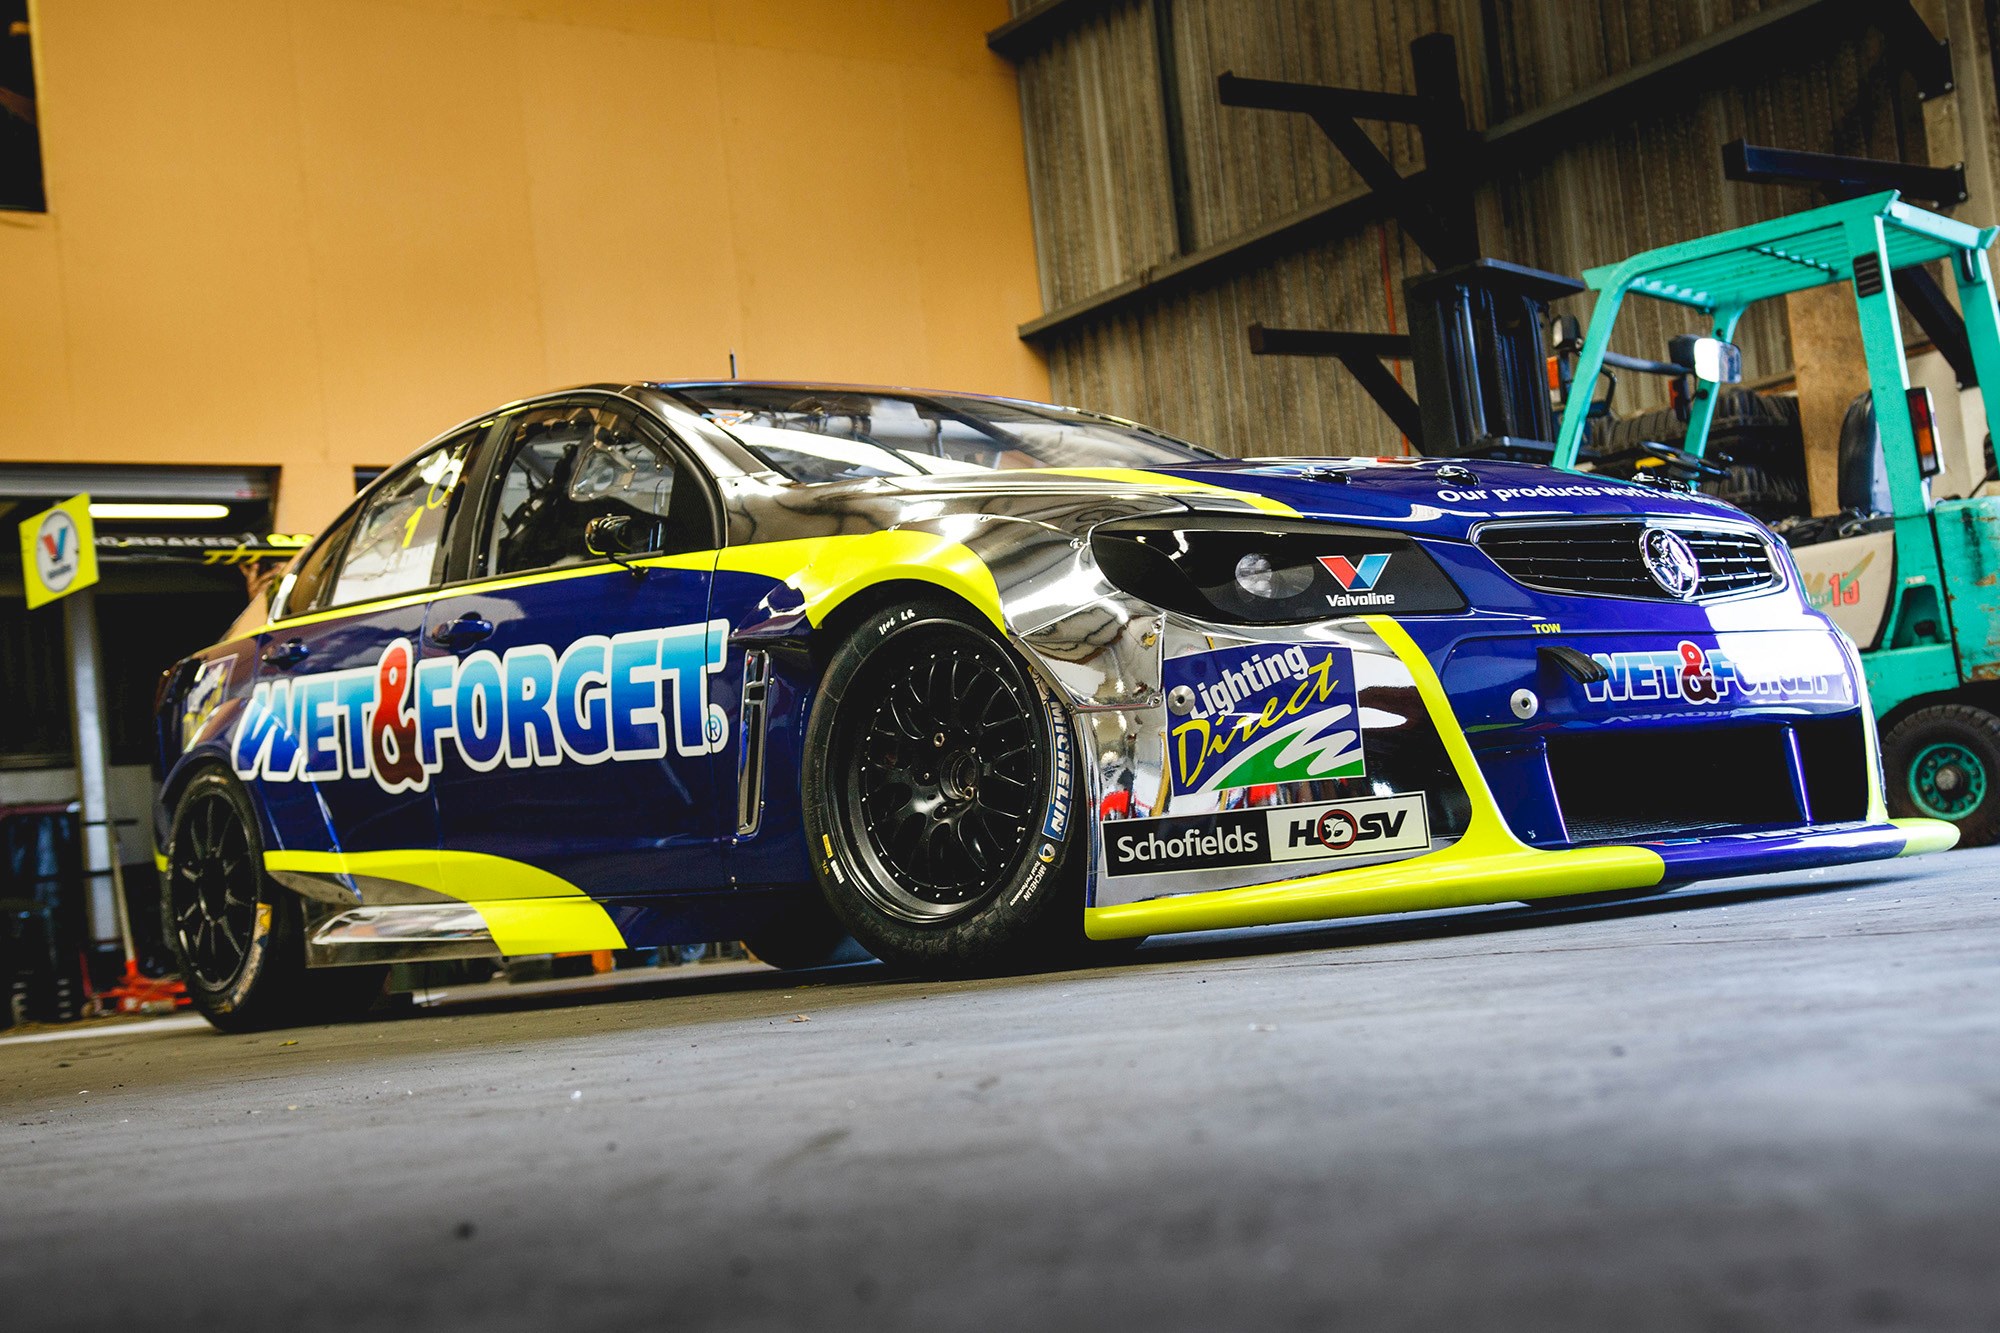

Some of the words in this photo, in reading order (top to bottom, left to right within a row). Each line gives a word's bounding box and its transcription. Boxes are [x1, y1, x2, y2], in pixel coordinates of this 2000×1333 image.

[1437, 488, 1488, 502] Our
[1491, 485, 1601, 502] products
[1326, 592, 1395, 607] Valvoline
[1531, 623, 1561, 634] TOW
[1172, 652, 1338, 787] Direct
[1050, 701, 1070, 835] MICHELIN
[1117, 825, 1258, 863] Schofields
[1023, 864, 1047, 901] MICHELIN
